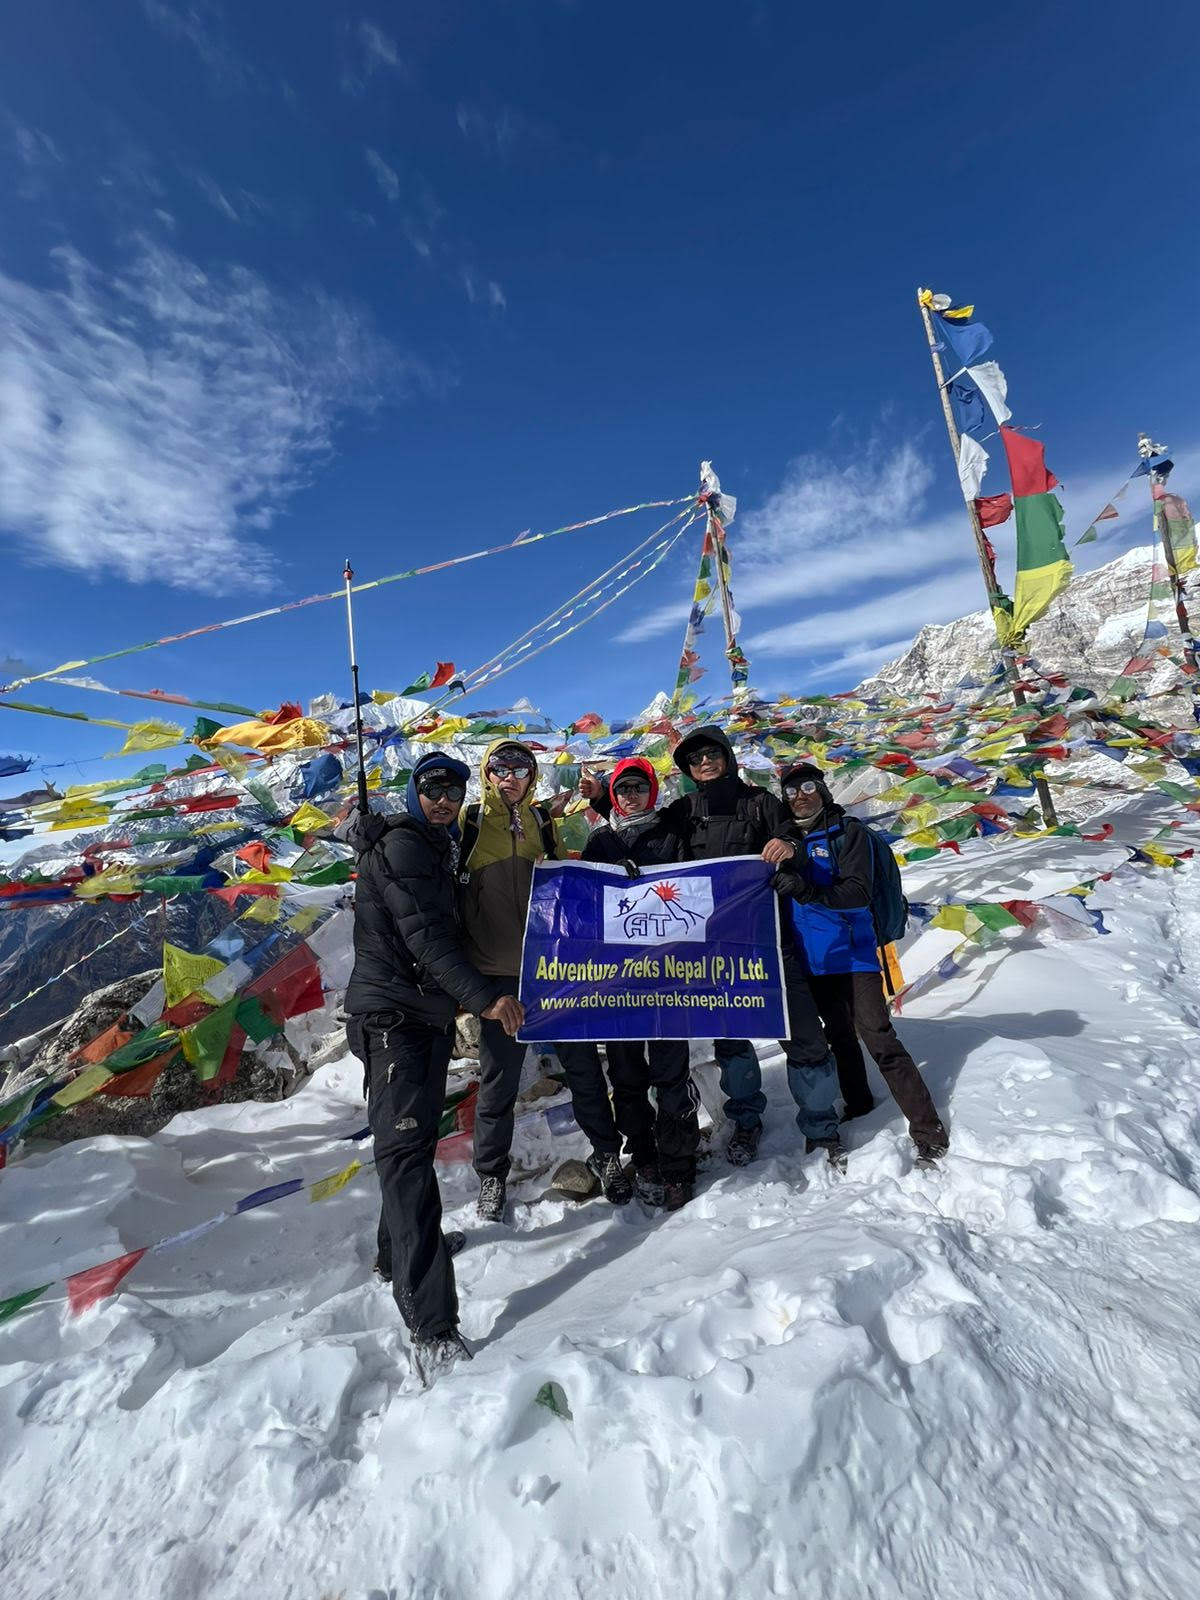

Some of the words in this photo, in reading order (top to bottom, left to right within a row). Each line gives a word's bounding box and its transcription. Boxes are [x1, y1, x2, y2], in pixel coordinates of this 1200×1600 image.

[535, 955, 618, 982] Adventure
[620, 955, 660, 979] Treks
[664, 954, 706, 984] Nepal
[711, 955, 735, 986] (P.)
[739, 956, 769, 981] Ltd.
[540, 991, 765, 1011] www.adventuretreksnepal.com
